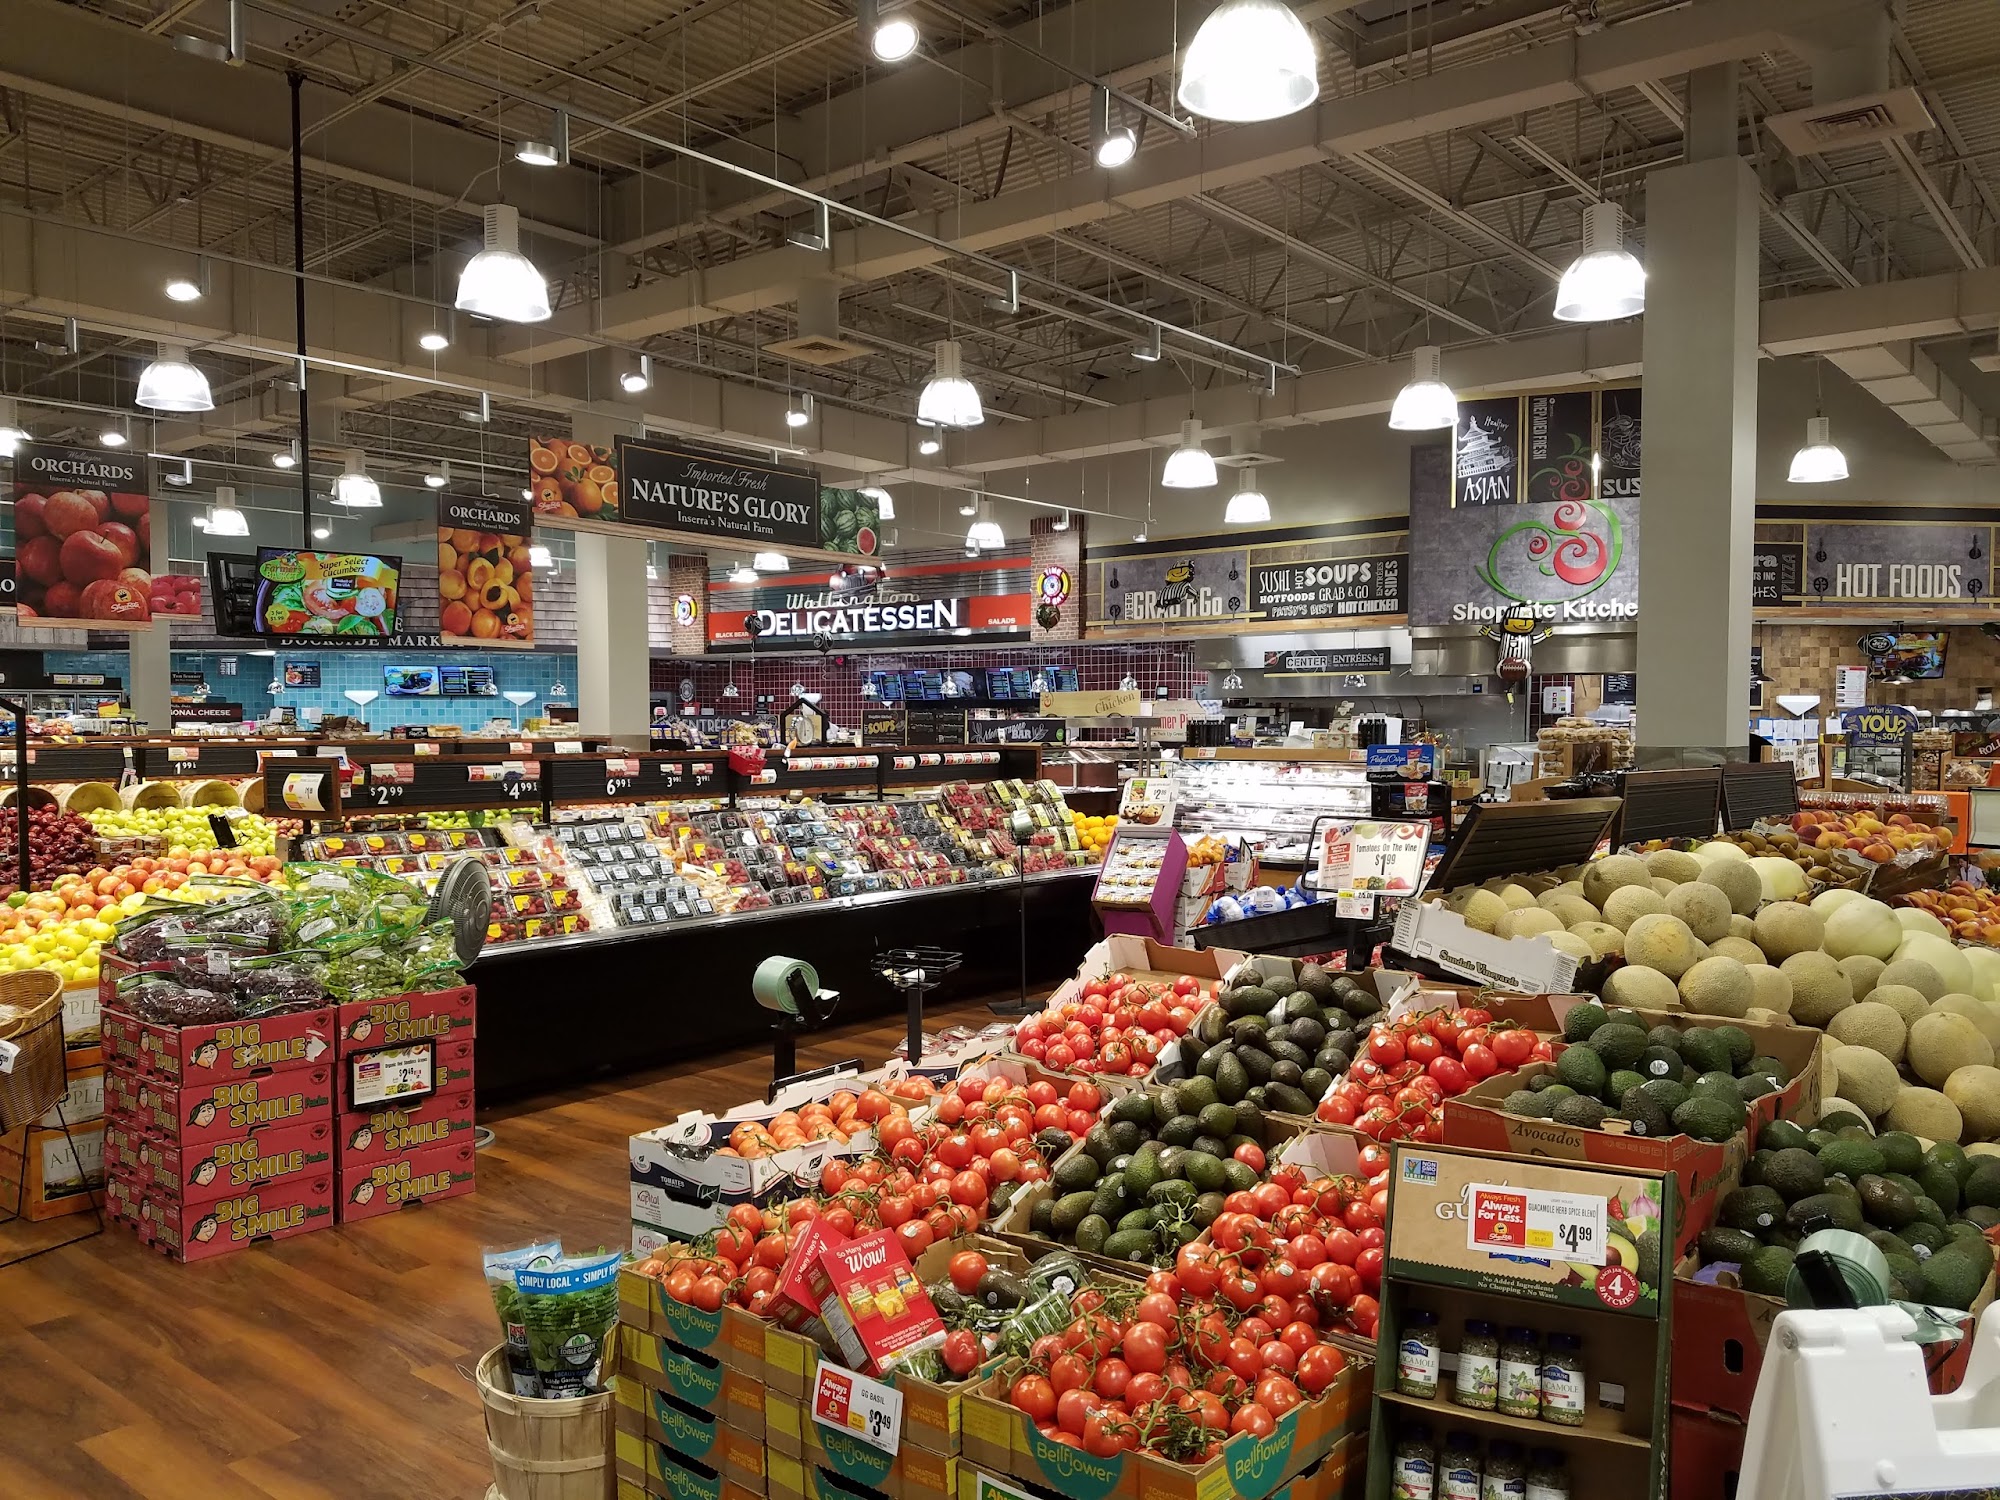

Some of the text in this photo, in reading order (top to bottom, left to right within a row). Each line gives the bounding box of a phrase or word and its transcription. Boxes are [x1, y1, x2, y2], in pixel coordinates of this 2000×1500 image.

[31, 457, 134, 481] ORCHARDS
[680, 462, 769, 491] Imported Fresh
[632, 478, 811, 525] NATURE'S GLORY
[1463, 475, 1510, 504] ASIAN
[450, 505, 521, 526] ORCHARDS
[677, 511, 774, 535] Inserra's Natural Farm
[319, 557, 371, 571] Super Select
[322, 565, 366, 579] Cucumbers
[1295, 562, 1372, 590] HOT SOUPS
[1782, 554, 1796, 594] PIZZA
[1259, 569, 1291, 594] SUSHI
[1384, 560, 1398, 597] SIDES
[1836, 563, 1962, 599] HOT FOODS
[786, 590, 921, 611] Wallington
[1200, 586, 1223, 617] Go
[1319, 585, 1369, 601] GRAB & GO
[757, 599, 958, 637] DELICATESSEN
[988, 617, 1016, 625] SALADS
[1286, 656, 1328, 668] CENTER
[1333, 652, 1379, 664] ENTRÉES &
[1095, 692, 1136, 714] Chicken
[1868, 706, 1893, 715] What do
[867, 720, 896, 736] SOUPS
[1011, 729, 1032, 740] BAR
[1859, 732, 1876, 740] have
[1876, 733, 1882, 741] to
[1356, 843, 1418, 853] Tomatoes On The Vine
[1439, 949, 1476, 972] Sundale
[1476, 961, 1520, 987] Vineyards
[370, 1001, 411, 1025] BIG
[215, 1023, 261, 1050] BIG
[385, 1015, 451, 1043] SMILE
[232, 1037, 306, 1070] SMILE
[213, 1081, 258, 1109] BIG
[230, 1094, 304, 1128] SMILE
[370, 1111, 409, 1134] BIG
[385, 1119, 450, 1152] SMILE
[1511, 1122, 1582, 1148] Avocados
[213, 1139, 259, 1167] BIG
[230, 1150, 304, 1186] SMILE
[371, 1160, 411, 1188] BIG
[386, 1170, 452, 1204] SMILE
[660, 1176, 686, 1188] TOMATES
[215, 1194, 259, 1224] BIG
[636, 1189, 661, 1205] Kapitol
[1481, 1199, 1520, 1214] Always
[231, 1204, 306, 1241] SMILE
[1478, 1209, 1496, 1221] For
[1497, 1211, 1524, 1224] Less.
[1528, 1203, 1597, 1218] GUACAMOLE HERB SPICE BLEND
[794, 1232, 820, 1285] So Many Ways to
[836, 1236, 886, 1260] So Many Ways to
[519, 1268, 609, 1289] SIMPLY LOCAL SIMPLY
[1483, 1275, 1554, 1293] No Added Ingredients
[1599, 1269, 1612, 1281] EACH
[1608, 1274, 1624, 1296] 4
[1489, 1283, 1522, 1295] Chopping
[1538, 1290, 1559, 1299] Waste
[1599, 1286, 1637, 1307] BATCHES!
[667, 1303, 719, 1334] Bellflower
[577, 1342, 596, 1354] GARDEN
[667, 1358, 719, 1391] Bellflower
[822, 1377, 848, 1394] Always
[819, 1385, 848, 1405] For Less.
[869, 1391, 885, 1405] BASIL
[909, 1409, 946, 1430] ON THE VINE
[912, 1404, 943, 1421] TOMATOES
[661, 1409, 713, 1444] Bellflower
[825, 1433, 890, 1471] Bellflower
[1036, 1441, 1115, 1484] Bellflower
[1235, 1429, 1297, 1481] Bellflower
[664, 1466, 717, 1500] Bellflower
